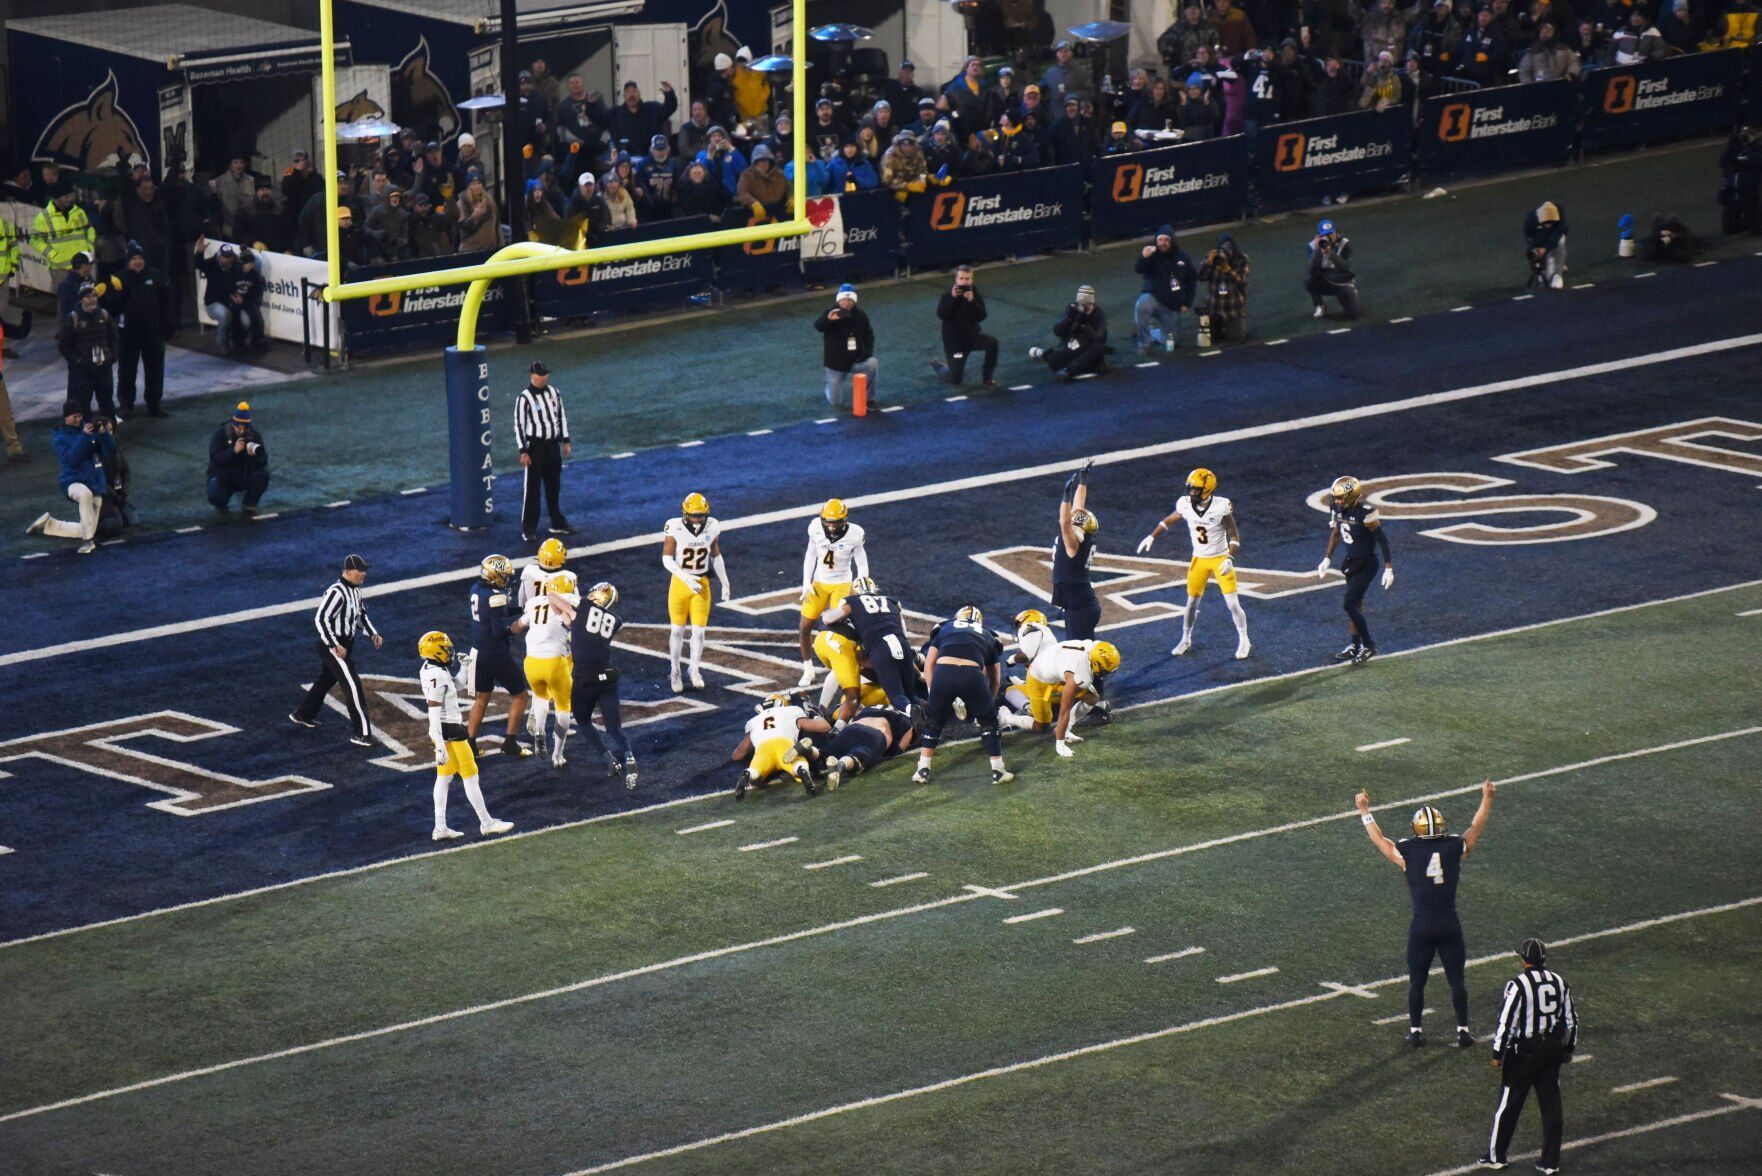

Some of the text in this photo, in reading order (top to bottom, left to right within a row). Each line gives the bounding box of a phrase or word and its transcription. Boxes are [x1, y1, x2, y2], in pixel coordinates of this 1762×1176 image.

[225, 64, 251, 75] Health
[1637, 77, 1669, 95] First
[1635, 83, 1725, 111] Interstate Bank
[1473, 105, 1503, 123] First
[1470, 112, 1559, 139] Interstate Bank
[1307, 133, 1338, 152] First
[1304, 140, 1393, 168] Interstate Bank
[1145, 165, 1175, 183] First
[1142, 171, 1230, 199] Interstate Bank
[967, 194, 1002, 212] First
[964, 200, 1063, 228] Interstate Bank
[812, 229, 837, 257] 76
[848, 226, 878, 243] Bank
[591, 253, 692, 282] Interstate Bank
[404, 290, 467, 313] Interstat
[477, 362, 497, 514] BOBCATS
[1341, 481, 1354, 492] M
[1074, 512, 1088, 524] M
[1195, 526, 1208, 544] 3
[1340, 522, 1354, 544] 6
[492, 560, 505, 571] M
[681, 547, 708, 570] 22
[823, 550, 835, 569] 4
[470, 593, 480, 622] 2
[534, 604, 549, 624] 11
[860, 595, 891, 614] 87
[585, 606, 616, 639] 88
[430, 678, 436, 688] 7
[1426, 852, 1444, 885] 4
[1538, 984, 1557, 1014] C
